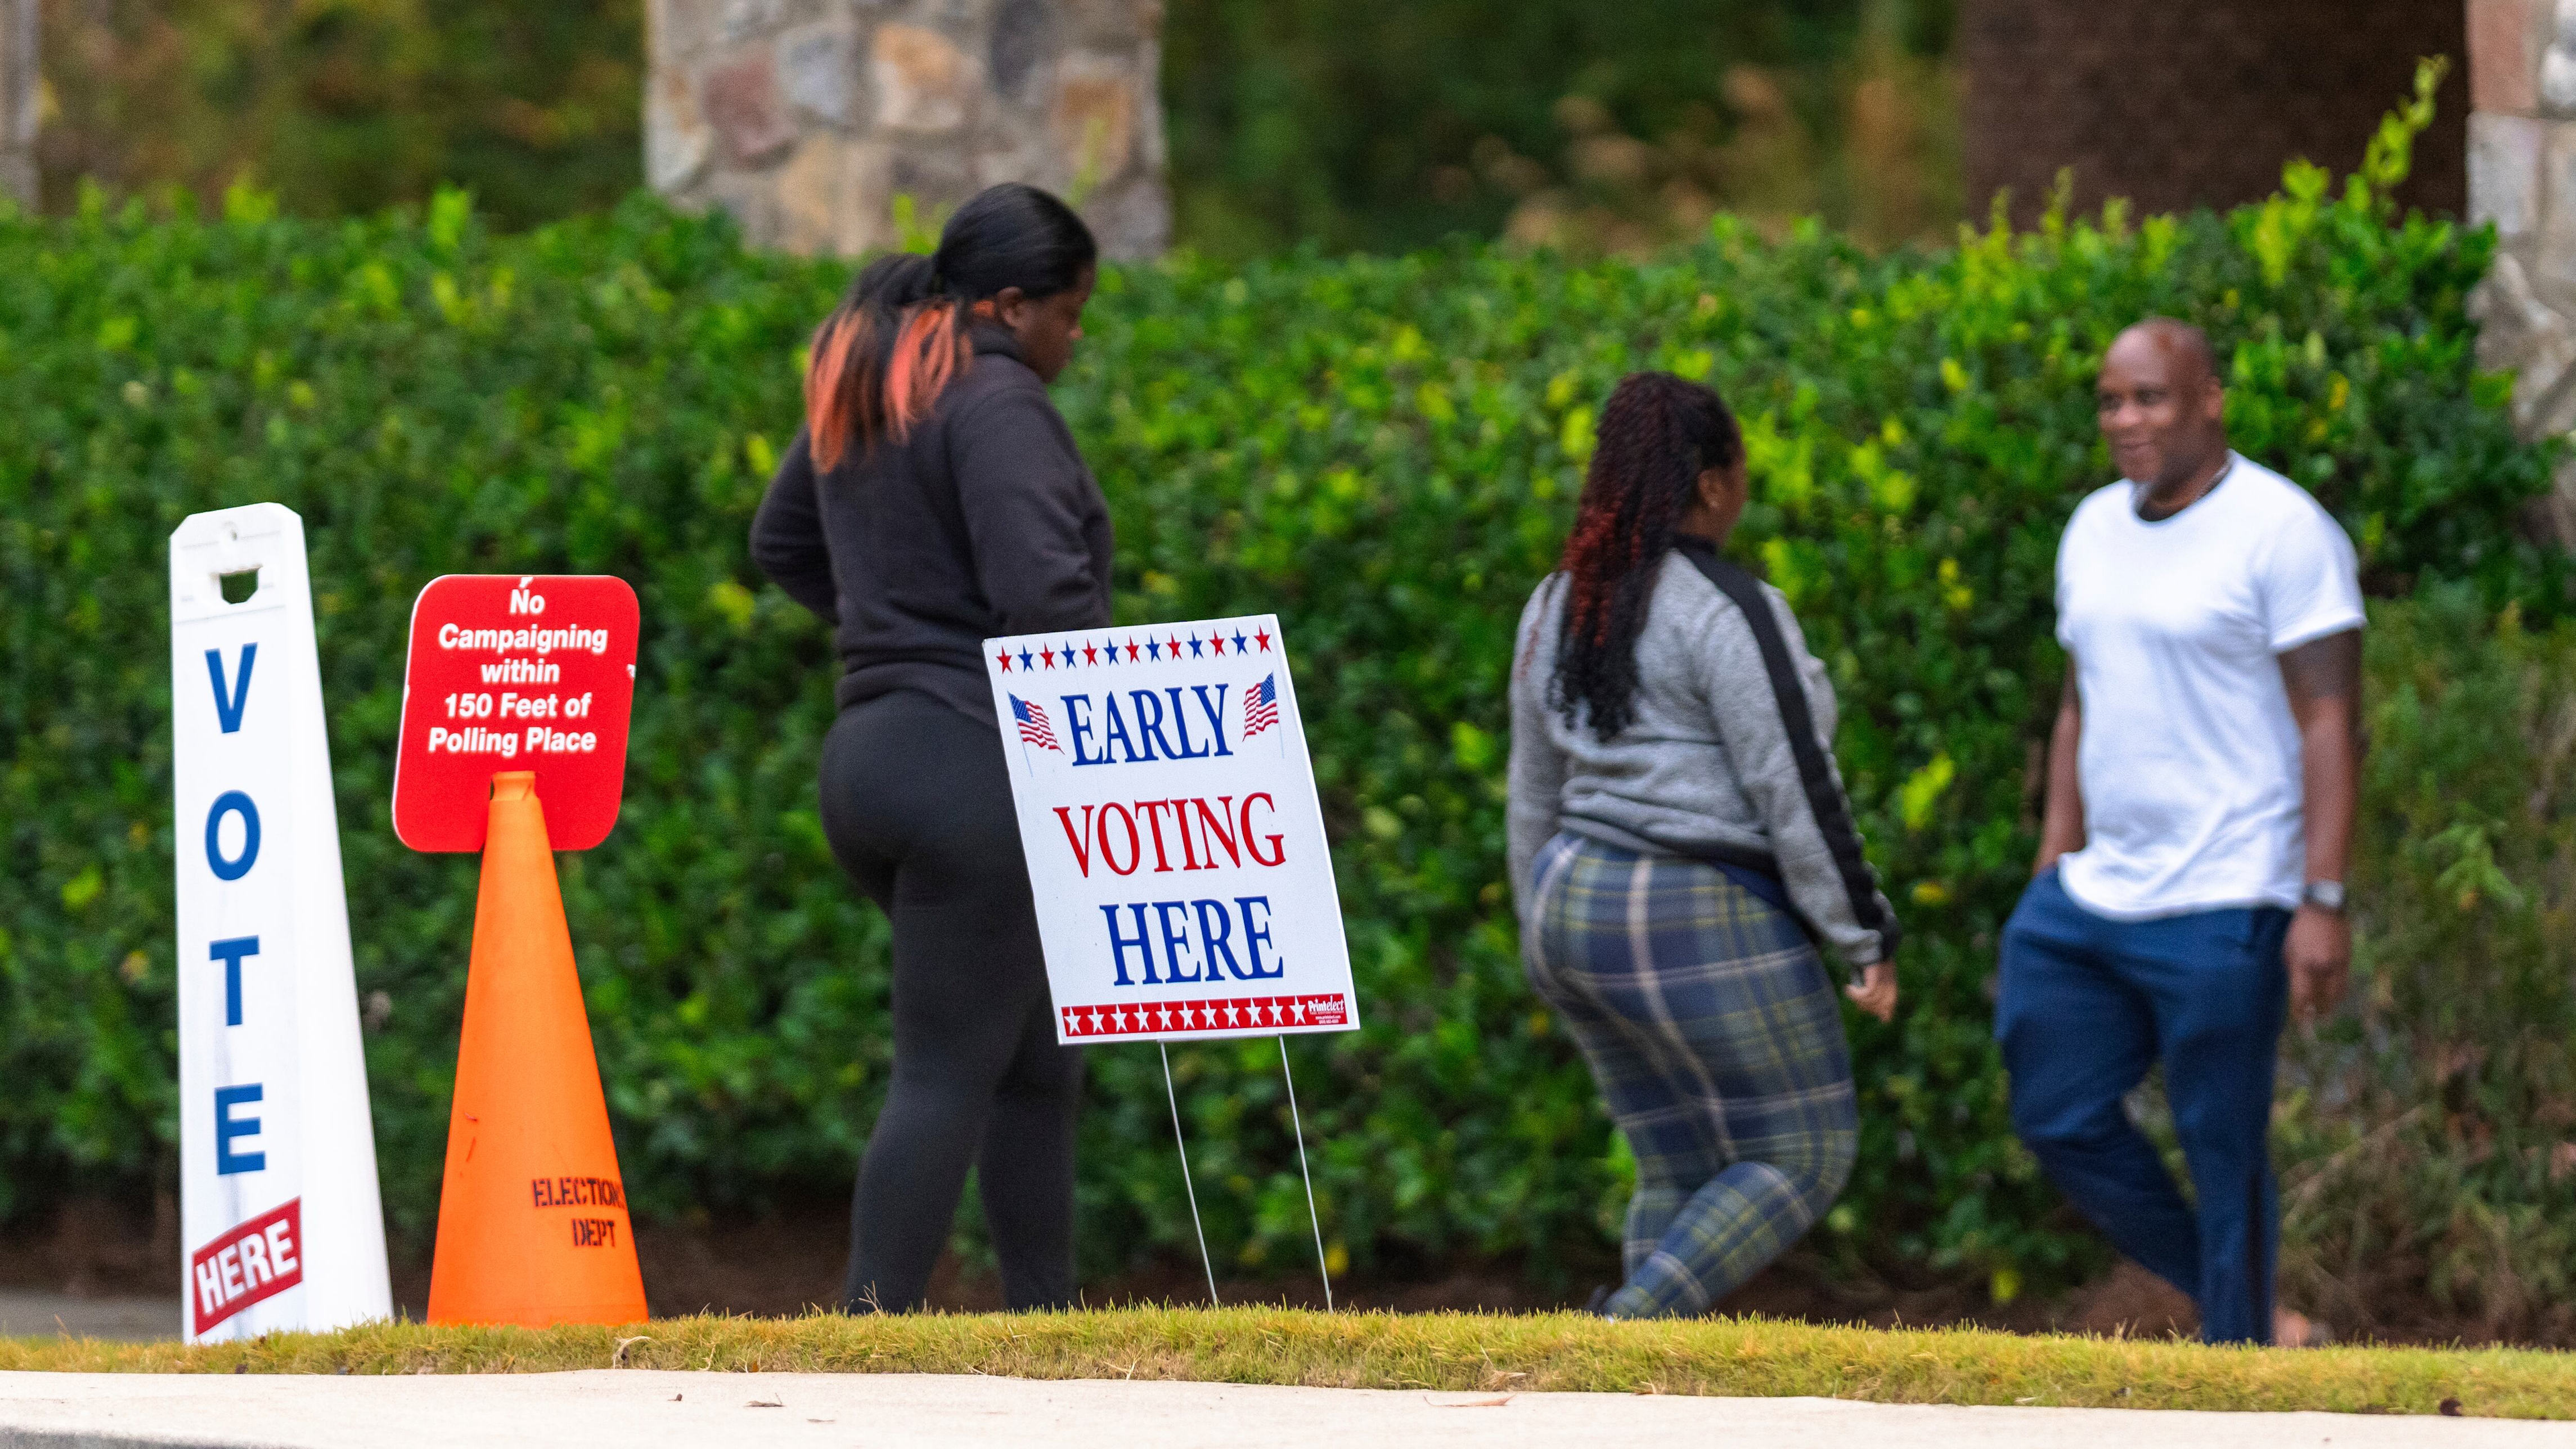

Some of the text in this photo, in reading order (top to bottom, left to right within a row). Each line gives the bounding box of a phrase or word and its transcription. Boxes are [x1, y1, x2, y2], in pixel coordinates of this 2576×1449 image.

[509, 587, 546, 615] No
[438, 623, 608, 655] Campaigning
[480, 658, 560, 684] within
[444, 692, 592, 719] 150 Feet of
[1060, 683, 1234, 767] EARLY
[428, 726, 597, 758] Polling Place
[1053, 791, 1286, 879] VOTING
[204, 642, 267, 1177] VOTE
[1099, 895, 1284, 987] HERE
[572, 1218, 615, 1246] DEPT
[195, 1218, 299, 1316] HERE
